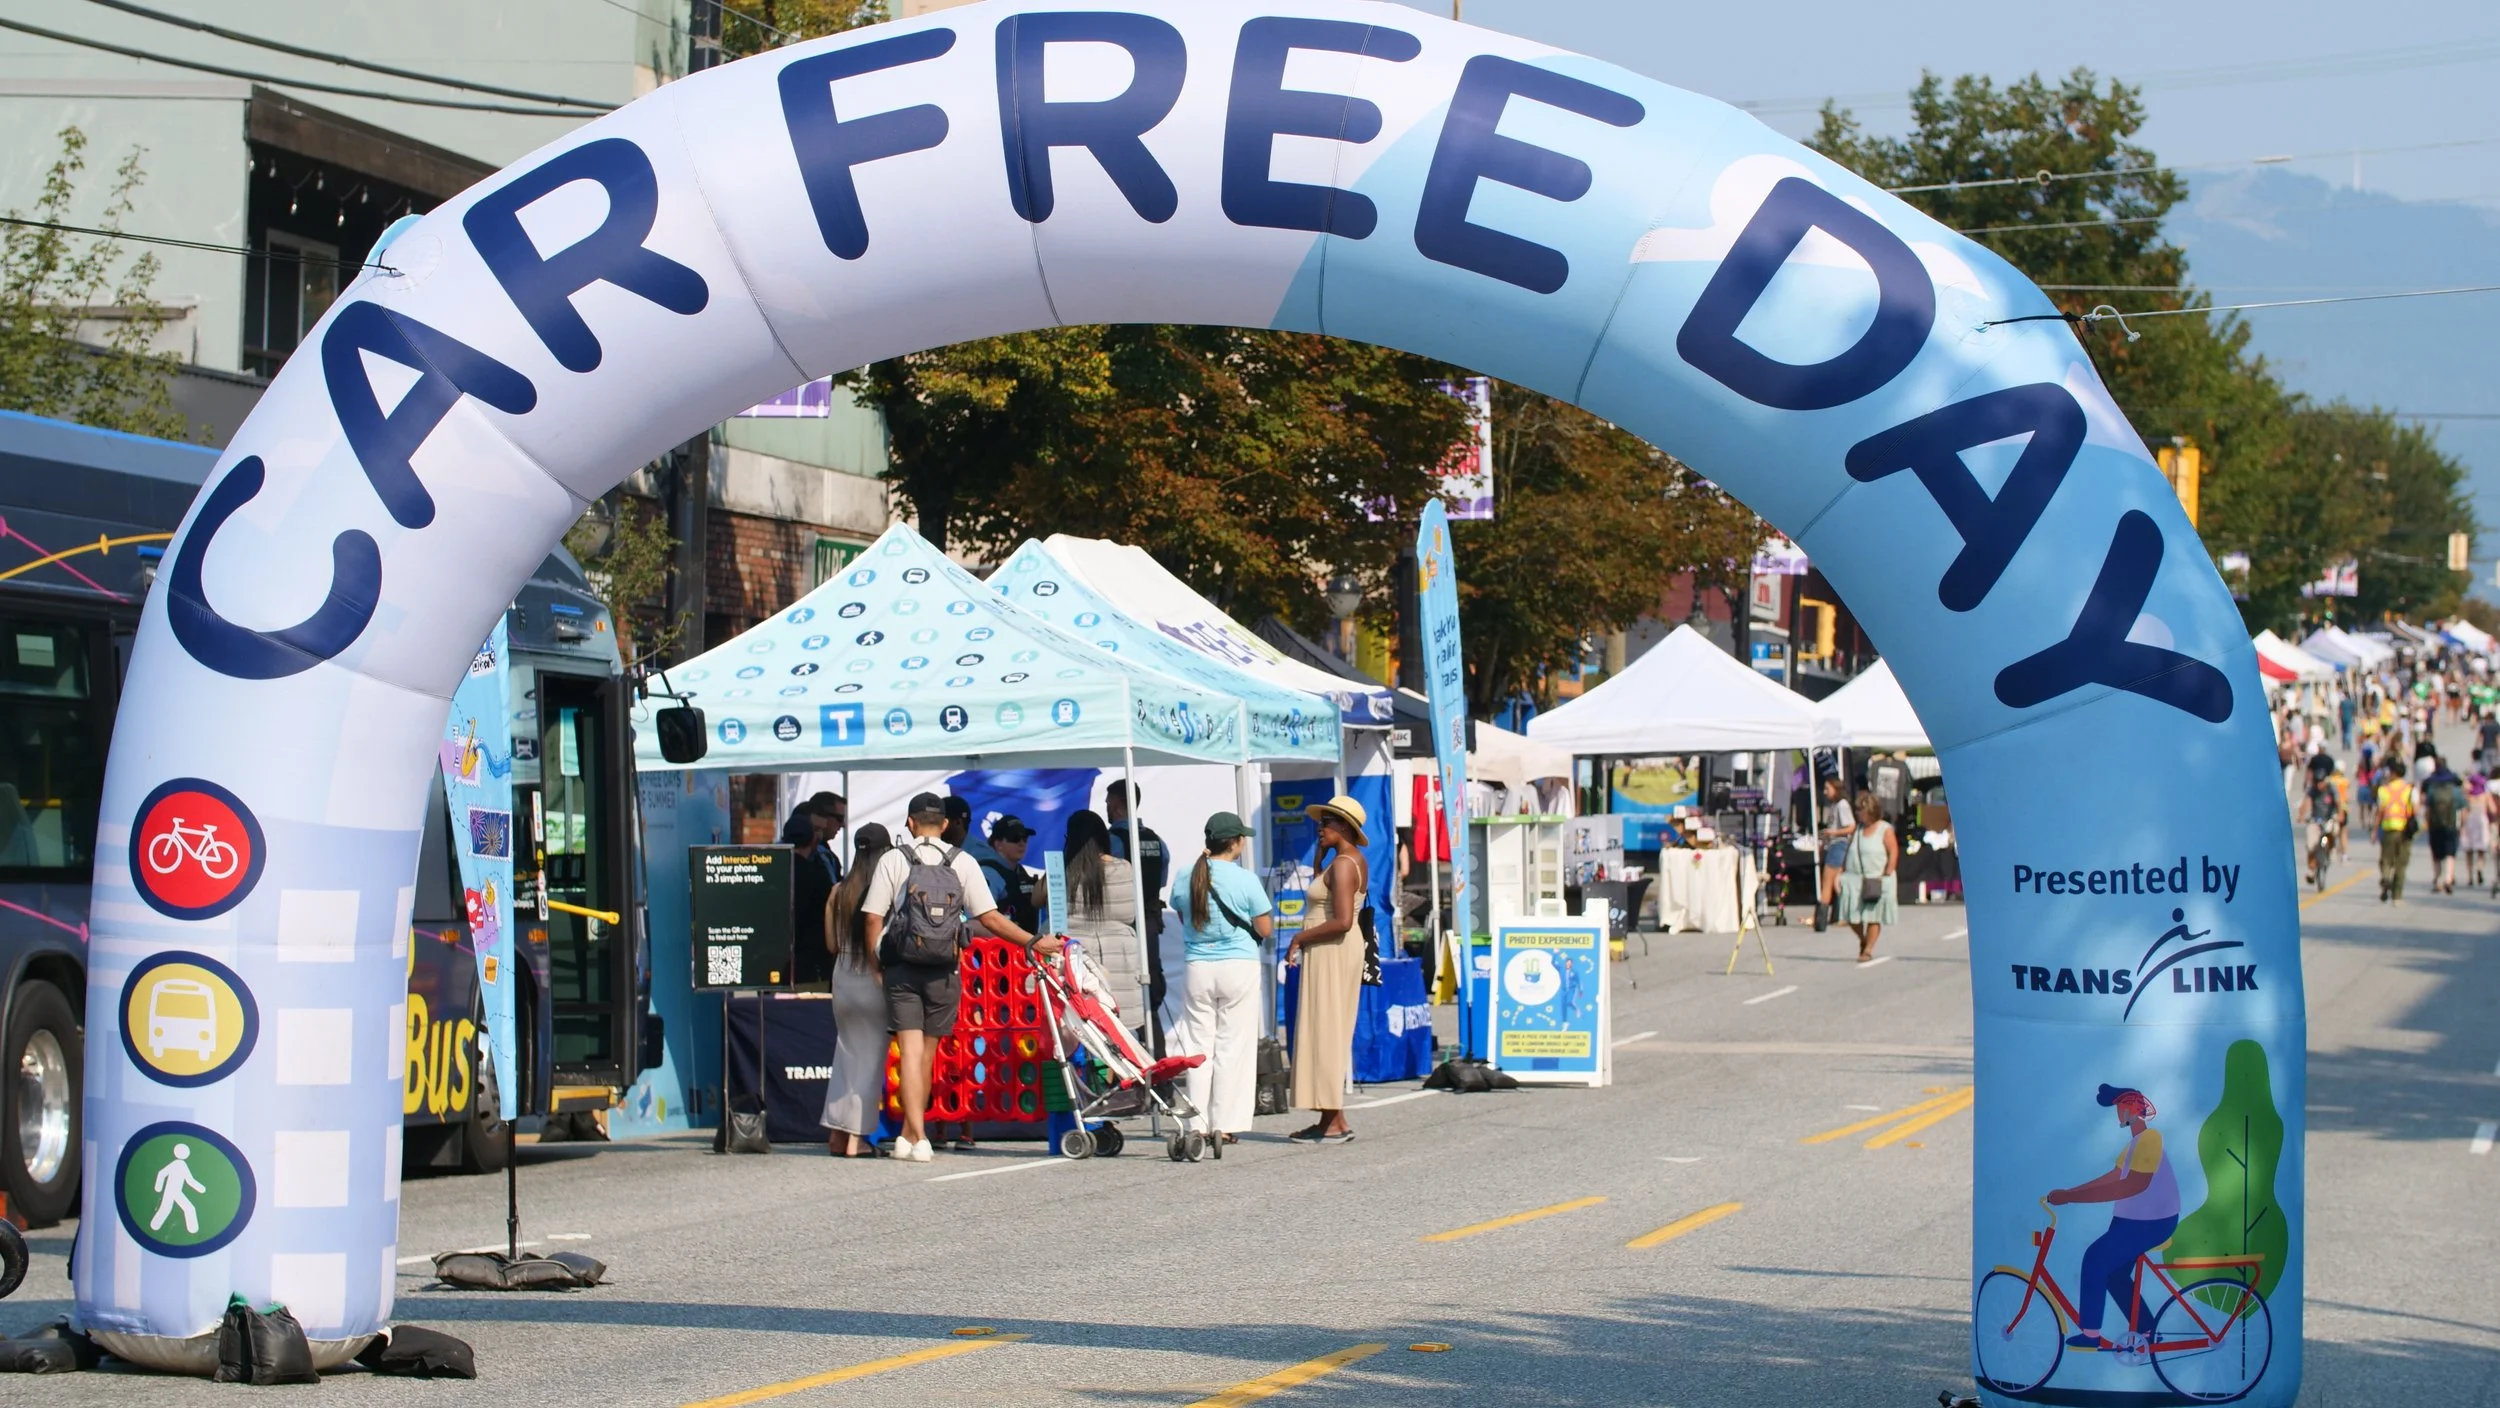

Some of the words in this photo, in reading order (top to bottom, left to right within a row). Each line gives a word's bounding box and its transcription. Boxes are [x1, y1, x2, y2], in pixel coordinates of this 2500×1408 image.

[167, 138, 709, 681] CAR
[778, 12, 1644, 295] FREE
[1676, 174, 2234, 724] DAY
[829, 710, 855, 741] T
[706, 855, 722, 865] Add
[751, 855, 773, 864] Debit
[706, 864, 716, 873] to
[716, 865, 733, 874] your
[733, 864, 758, 874] phone
[706, 874, 714, 883] in
[720, 874, 743, 885] simple
[2013, 856, 2189, 895] Presented
[2202, 855, 2241, 904] by
[1508, 935, 1537, 945] PHOTO
[1538, 935, 1590, 945] EXPERIENCE!
